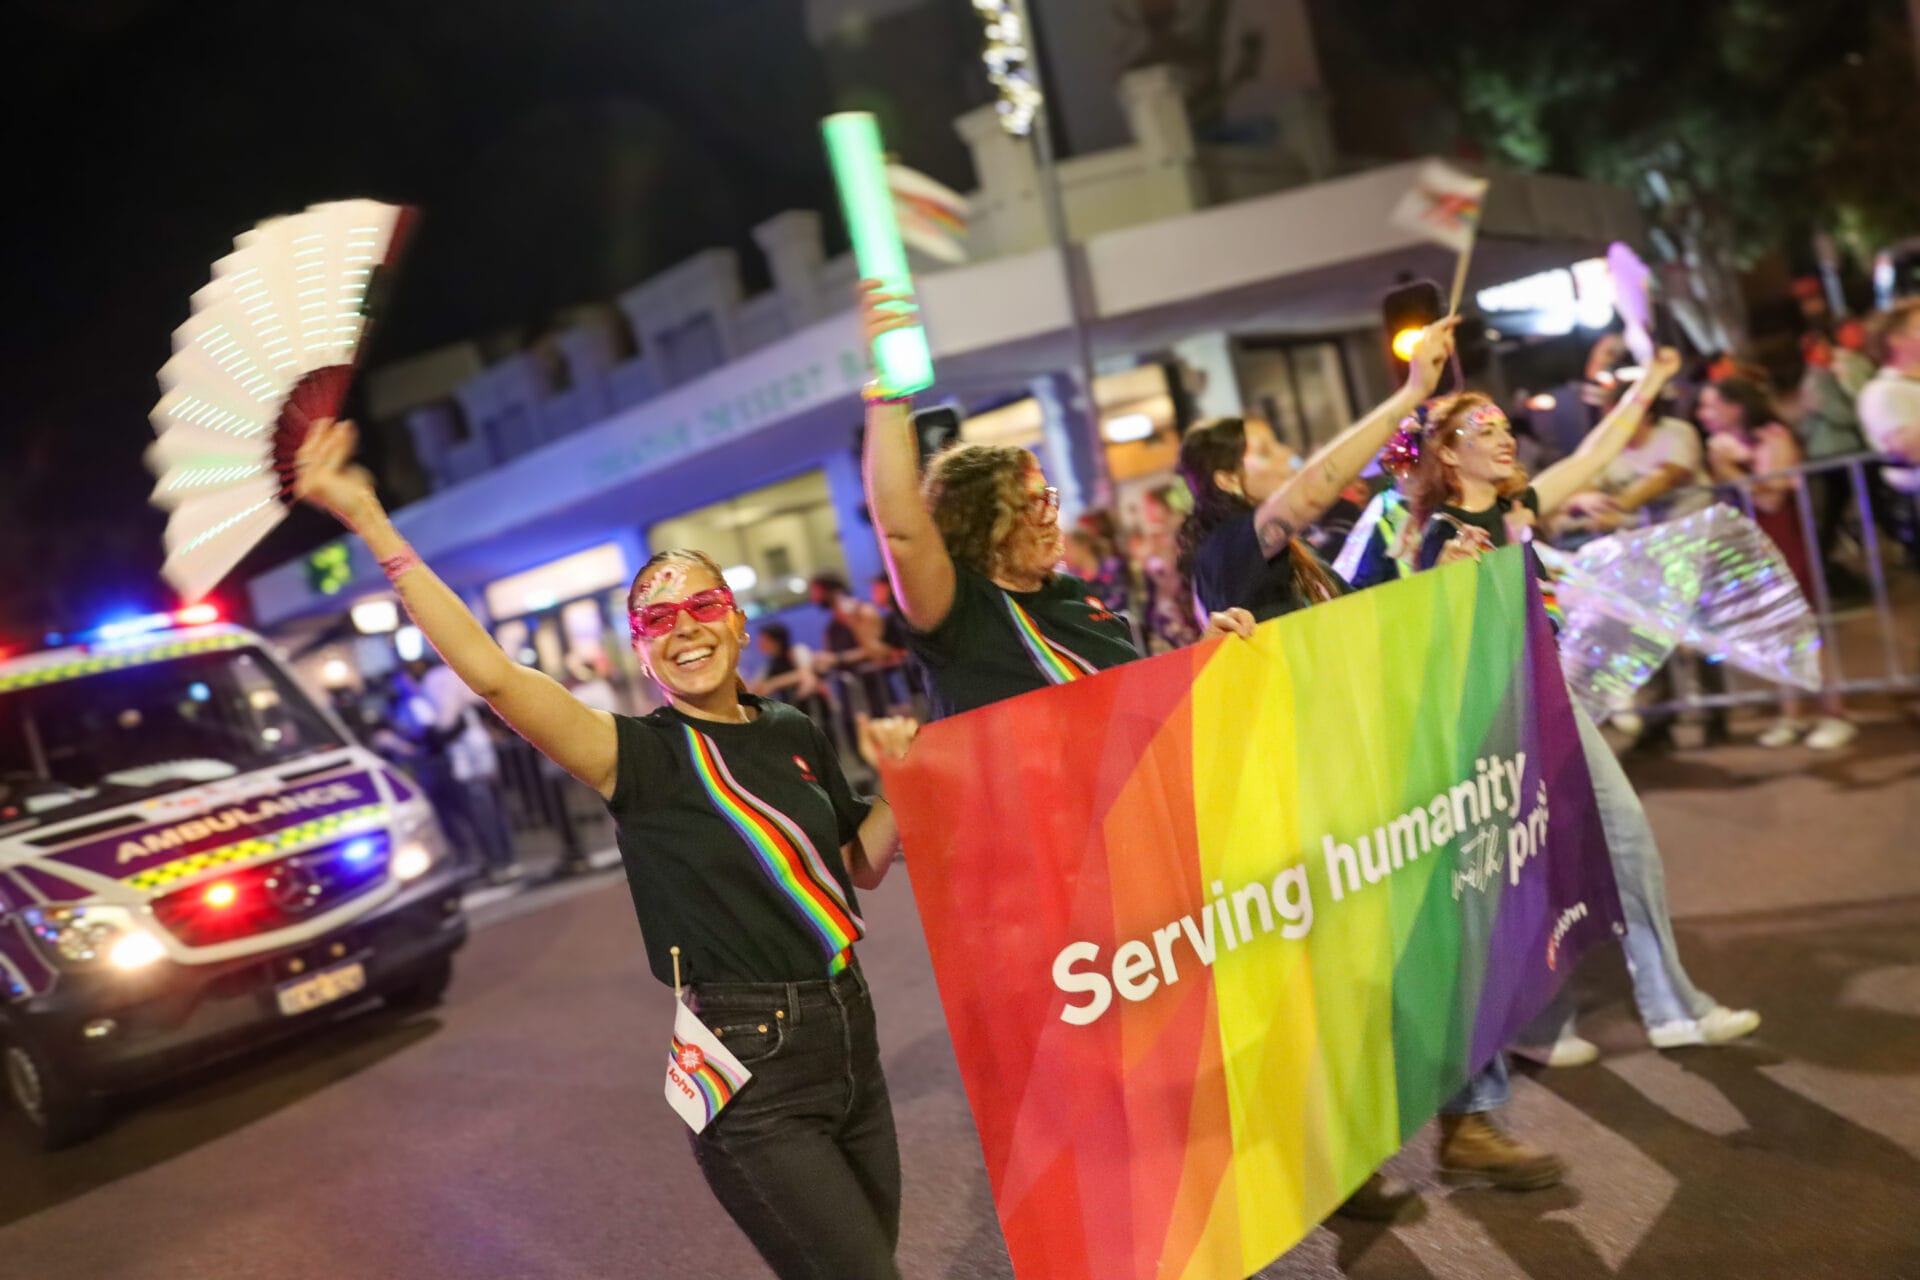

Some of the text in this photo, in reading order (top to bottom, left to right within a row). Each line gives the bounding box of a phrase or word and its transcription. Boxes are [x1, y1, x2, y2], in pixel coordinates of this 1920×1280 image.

[115, 782, 363, 864] AMBULANCE
[1051, 751, 1527, 1027] Serving humanity
